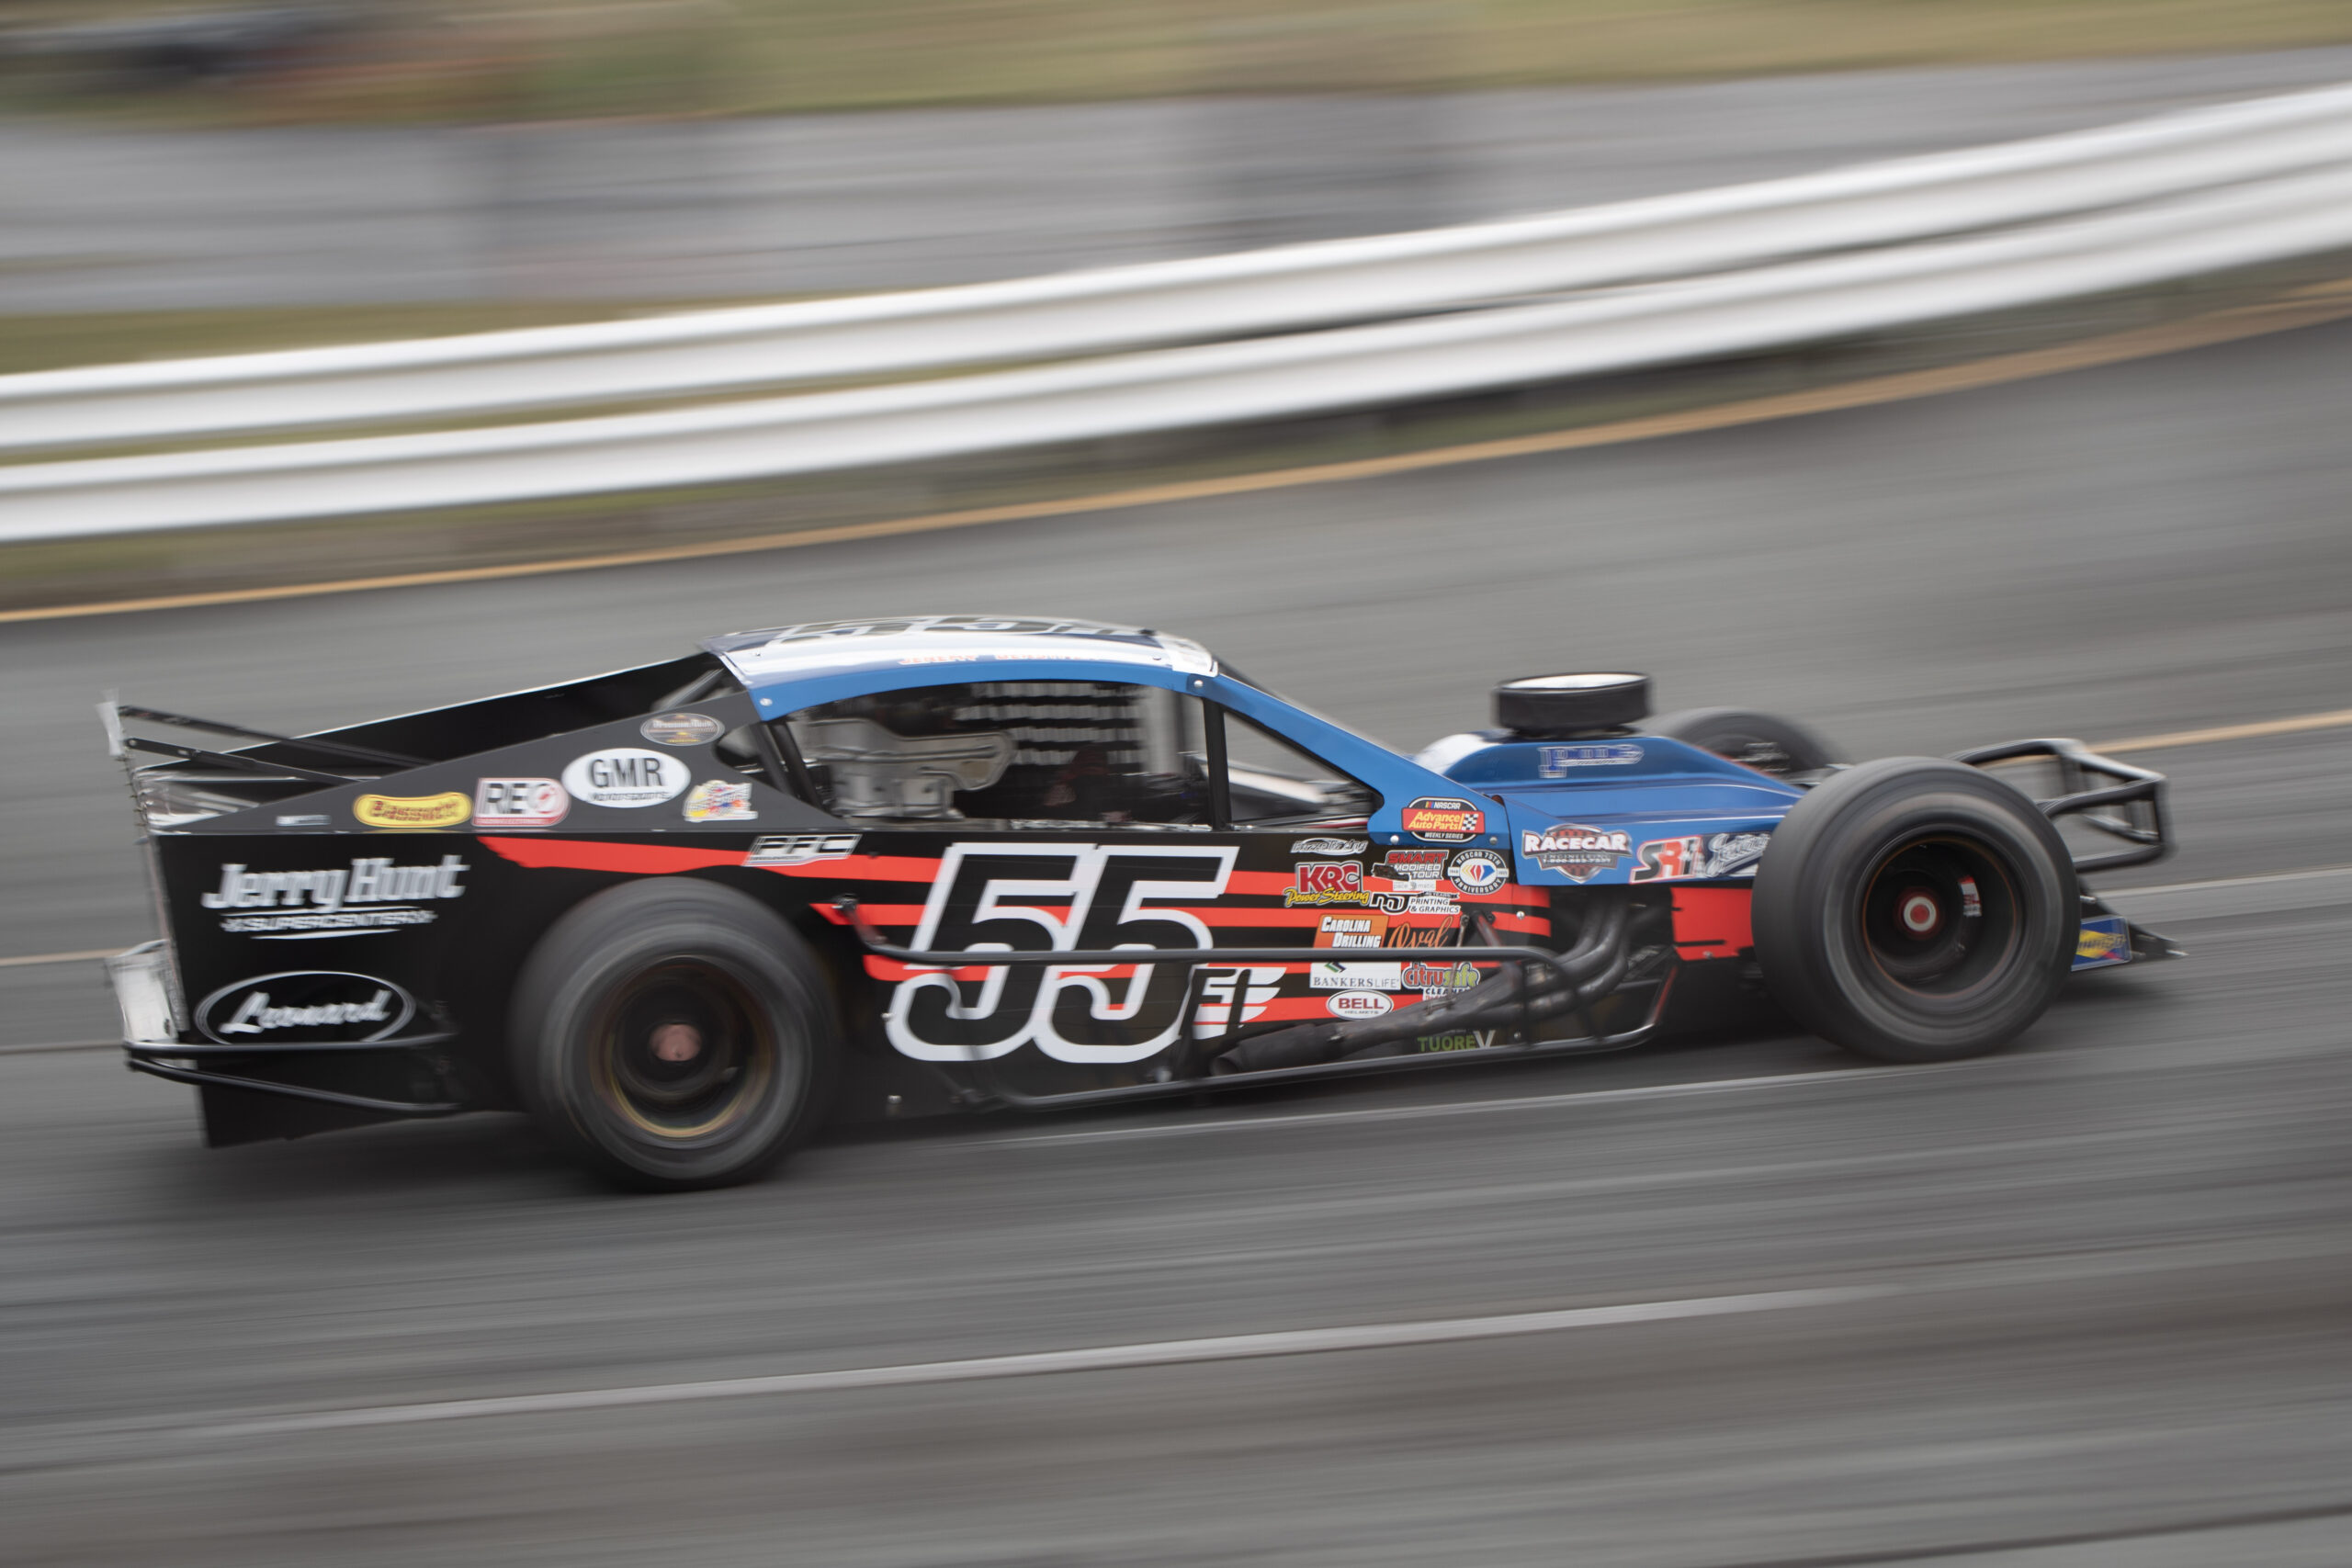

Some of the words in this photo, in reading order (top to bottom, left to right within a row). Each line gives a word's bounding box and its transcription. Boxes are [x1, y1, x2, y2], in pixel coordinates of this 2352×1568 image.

[590, 757, 662, 788] GMR
[1433, 801, 1461, 809] NASCAR
[1408, 819, 1432, 829] Auto
[1433, 821, 1459, 830] Parts
[1414, 811, 1461, 822] Advance
[1524, 833, 1627, 852] RACECAR
[1386, 852, 1447, 864] SMART
[1455, 851, 1483, 864] NASCAR
[1484, 852, 1501, 865] 75TH
[1393, 863, 1442, 872] MODIFIED
[200, 863, 350, 914] Jerry
[345, 854, 470, 902] Hunt
[1299, 864, 1360, 893] KRC
[1454, 877, 1502, 894] ANNIVERSARY
[1283, 887, 1321, 907] Power
[1317, 886, 1370, 905] Steering
[1320, 916, 1372, 932] CAROLINA
[1387, 916, 1453, 948] Oval
[1332, 931, 1382, 948] DRILLING
[886, 841, 1240, 1063] 55
[1338, 998, 1384, 1010] BELL
